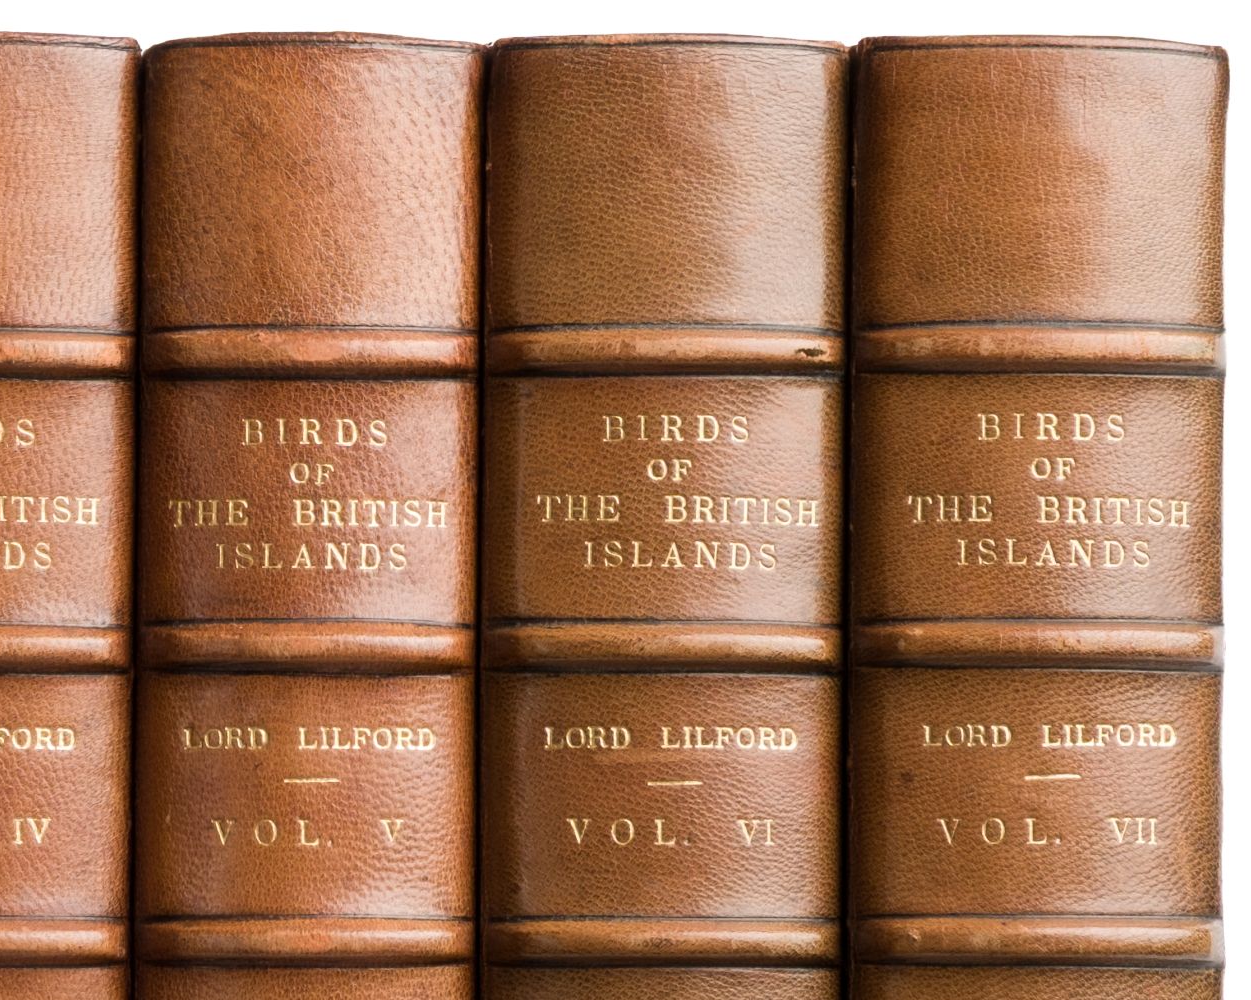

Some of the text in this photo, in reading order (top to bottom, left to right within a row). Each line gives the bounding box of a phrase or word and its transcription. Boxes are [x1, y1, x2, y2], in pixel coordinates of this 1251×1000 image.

[242, 418, 389, 447] BIRDS
[603, 414, 751, 443] BIRDS
[978, 413, 1126, 442] BIRDS
[289, 461, 335, 486] OF
[646, 458, 693, 482] OF
[1030, 457, 1077, 481] OF
[168, 498, 449, 529] THE BRITISH
[537, 494, 819, 528] THE BRITISH
[907, 494, 1191, 529] THE BRITISH
[216, 542, 408, 571] ISLANDS
[584, 540, 777, 570] ISLANDS
[957, 537, 1152, 568] ISLANDS
[183, 726, 437, 751] LORD LILFORD
[544, 726, 799, 751] LORD LILFORD
[922, 723, 1178, 749] LORD LILFORD
[13, 817, 52, 845] IV
[210, 818, 405, 847] VOL. V
[567, 818, 776, 846] VOL. VI
[936, 817, 1159, 846] VOL. VII
